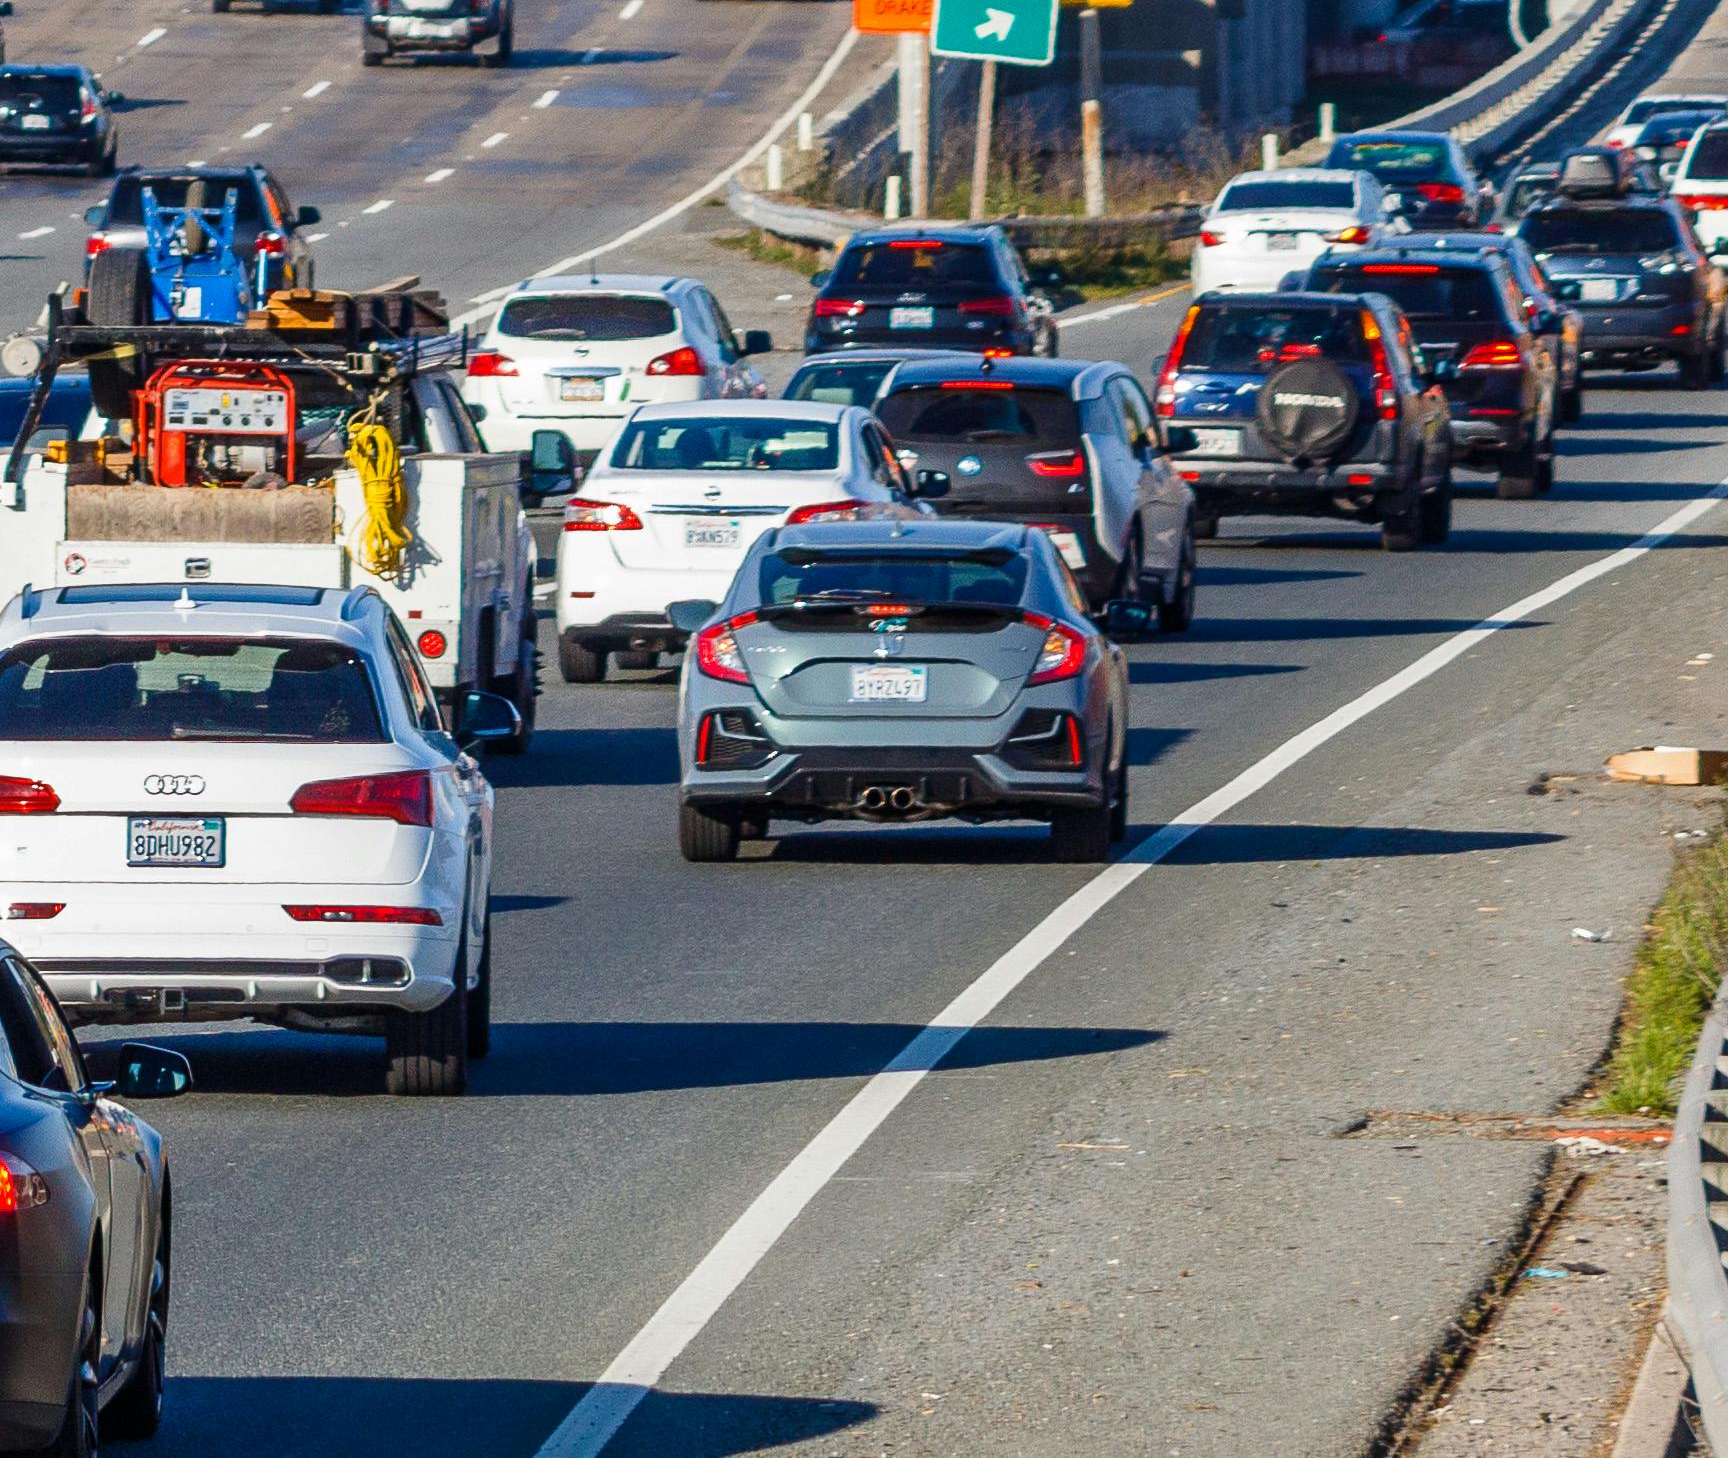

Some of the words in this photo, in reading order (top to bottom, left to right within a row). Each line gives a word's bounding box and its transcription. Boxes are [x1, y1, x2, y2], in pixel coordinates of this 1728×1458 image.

[874, 0, 932, 15] DRAKE
[1274, 393, 1345, 408] HONDA
[134, 835, 216, 857] 8DHU982
